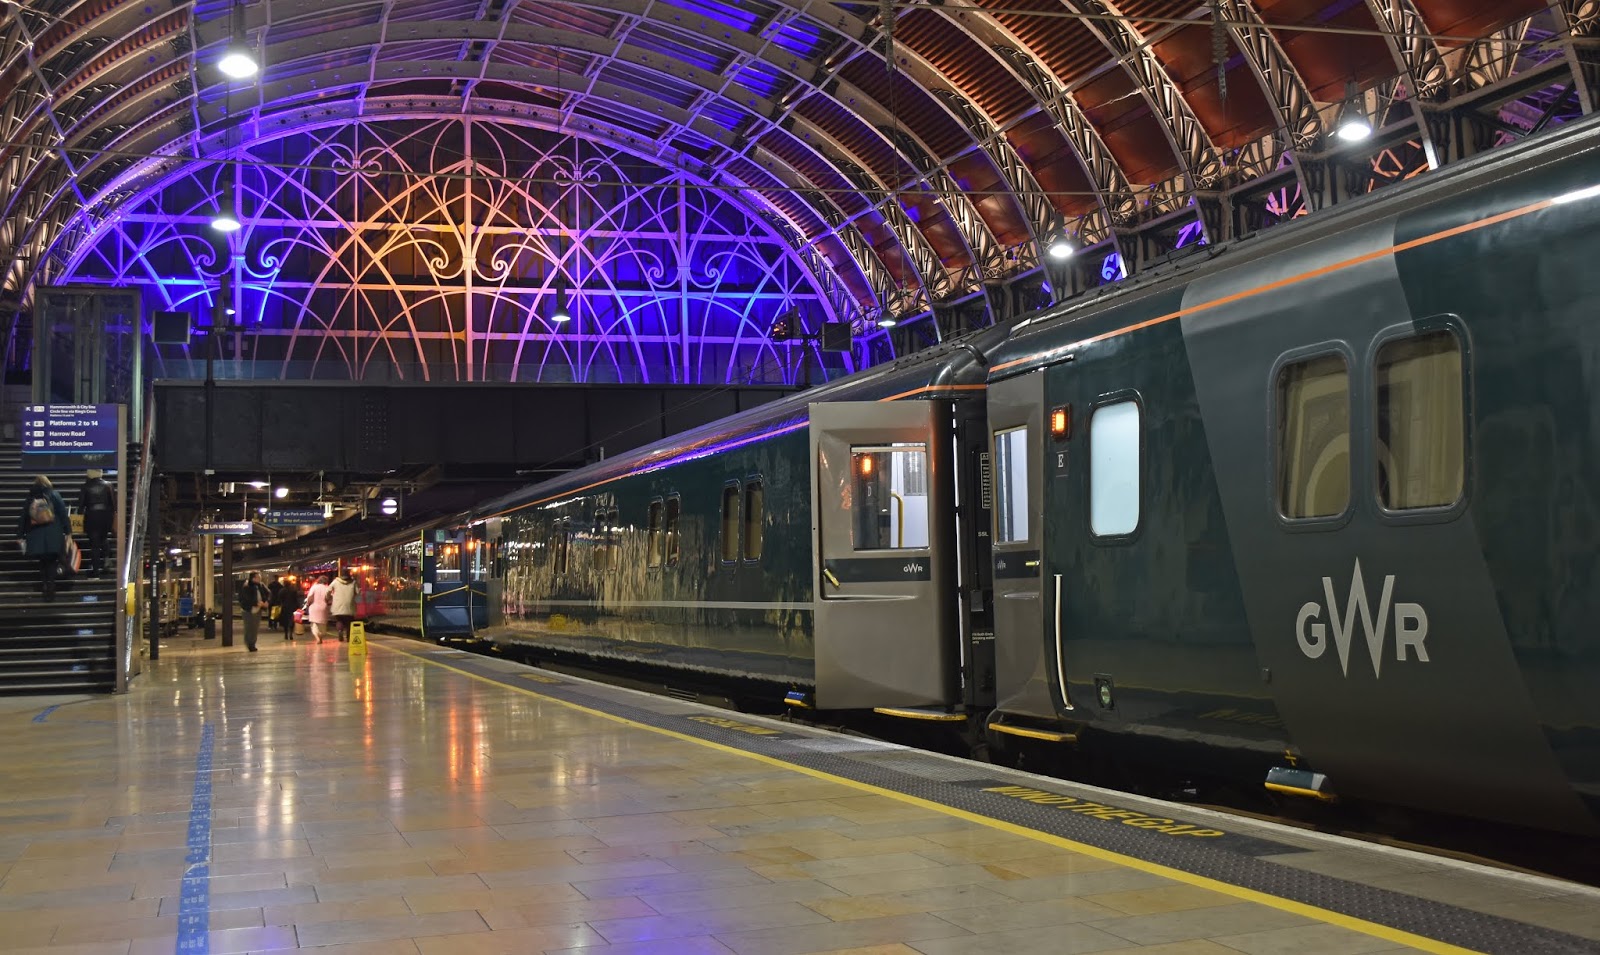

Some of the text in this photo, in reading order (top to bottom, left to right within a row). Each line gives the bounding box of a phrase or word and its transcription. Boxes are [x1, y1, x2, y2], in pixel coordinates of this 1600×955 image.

[1057, 453, 1064, 468] E
[903, 562, 923, 573] GWR
[1295, 556, 1430, 680] GWR
[983, 785, 1225, 837] MIND THE GAP
